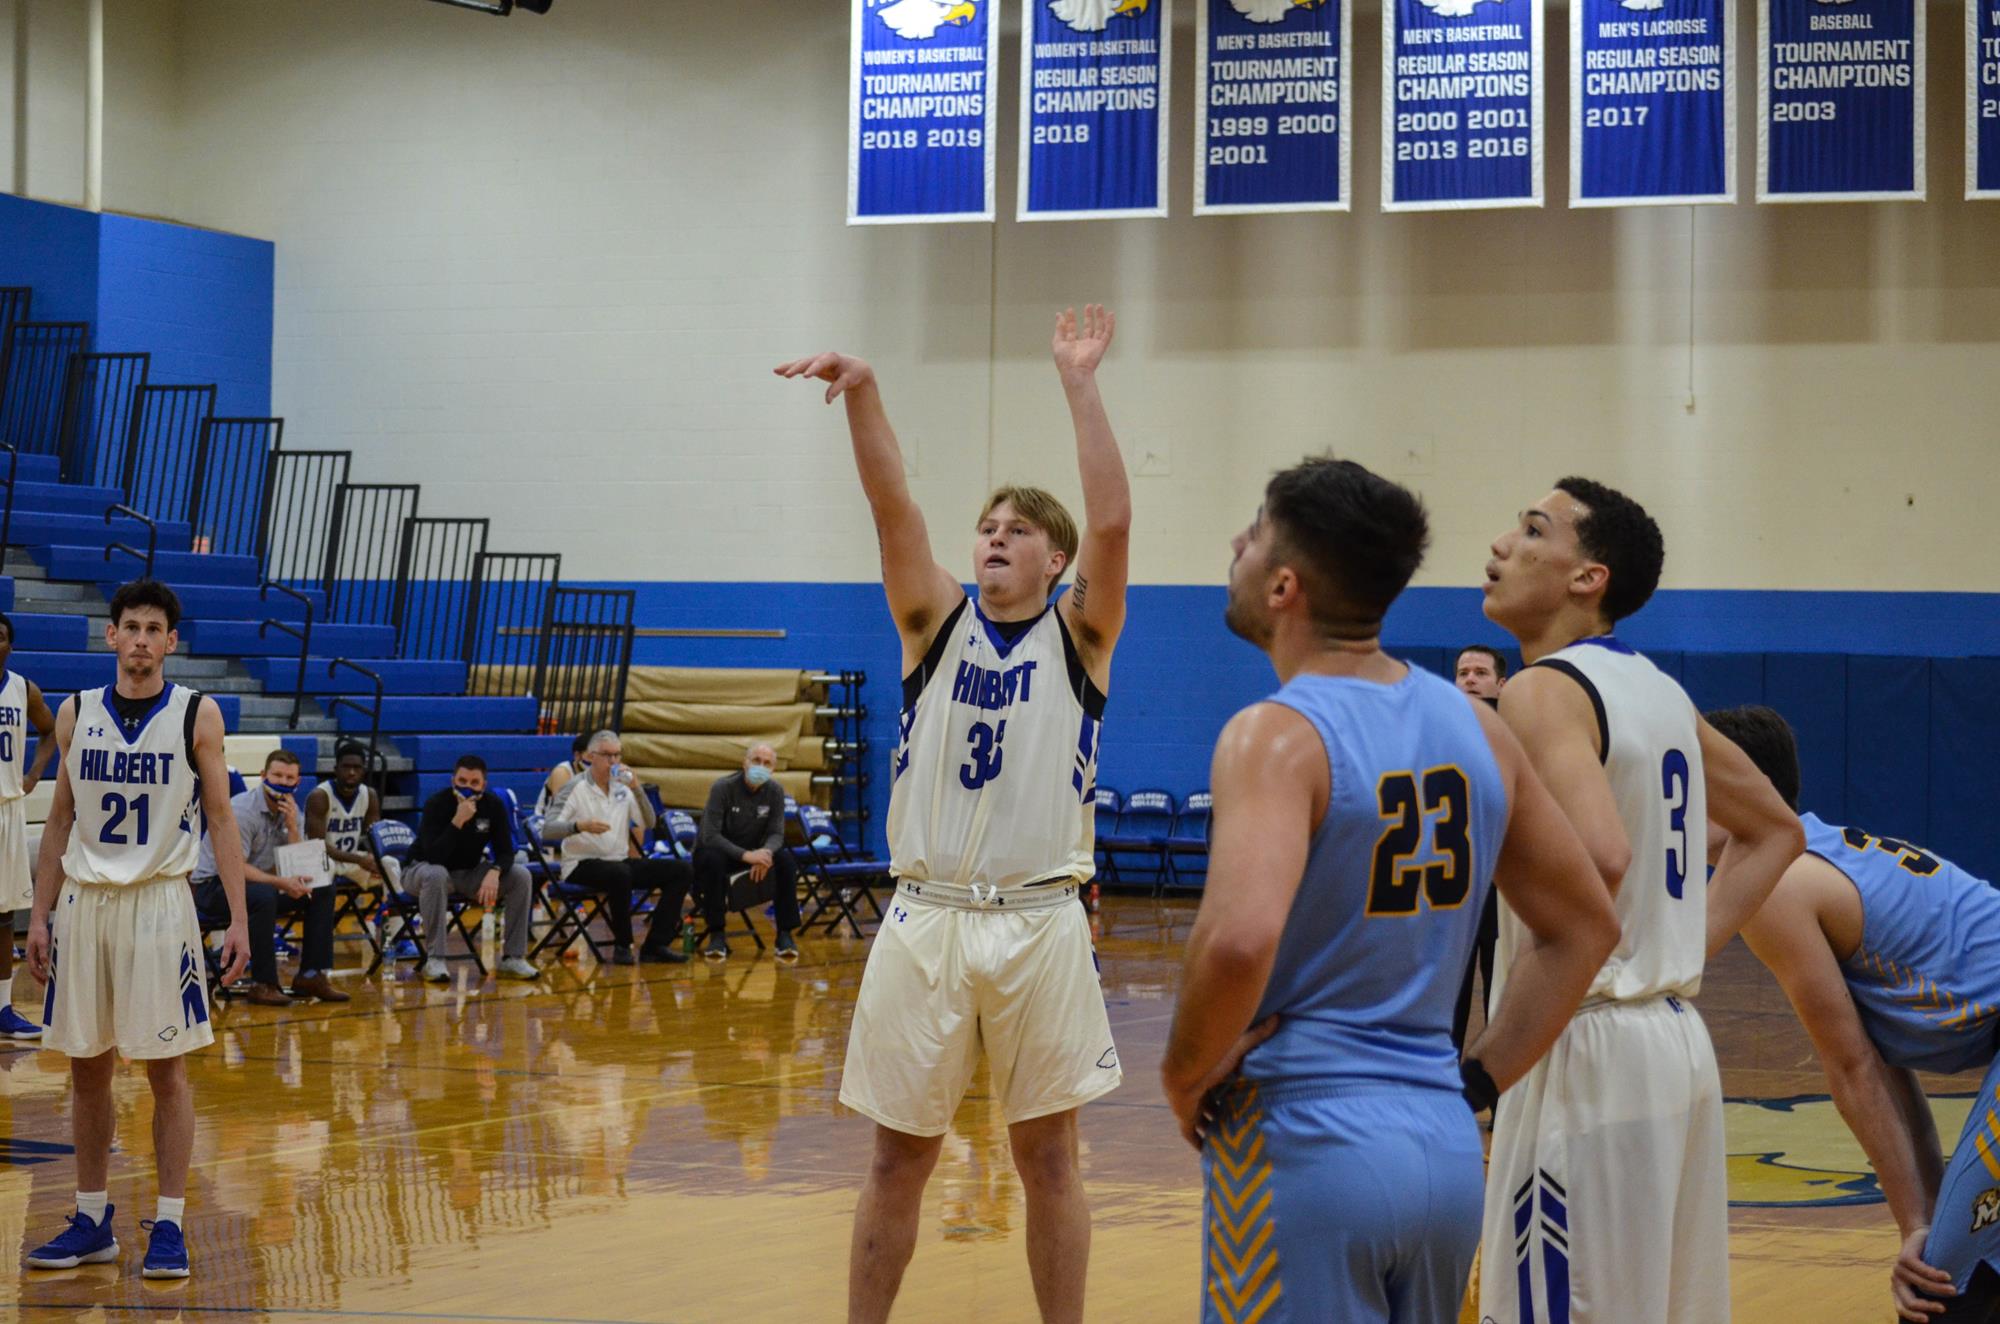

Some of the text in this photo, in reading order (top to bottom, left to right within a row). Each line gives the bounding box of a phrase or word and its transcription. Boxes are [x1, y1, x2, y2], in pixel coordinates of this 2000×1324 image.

[1599, 19, 1707, 37] MEN'S LACROSSE
[1811, 14, 1872, 30] BASEBALL
[1217, 32, 1332, 50] MEN'S BASKETBALL
[1404, 25, 1522, 44] MEN'S BASKETBALL
[864, 47, 983, 65] WOMEN'S BASKETBALL
[1035, 40, 1156, 58] WOMEN'S BASKETBALL
[1587, 45, 1719, 69] REGULAR SEASON
[1774, 40, 1910, 63] TOURNAMENT
[1211, 57, 1337, 82] TOURNAMENT
[1398, 51, 1528, 75] REGULAR SEASON
[864, 71, 983, 96] TOURNAMENT
[1035, 66, 1156, 88] REGULAR SEASON
[1399, 74, 1528, 100] CHAMPIONS
[1587, 67, 1720, 95] CHAMPIONS
[1774, 64, 1910, 89] CHAMPIONS
[1035, 87, 1155, 113] CHAMPIONS
[1211, 80, 1337, 105] CHAMPIONS
[864, 93, 982, 119] CHAMPIONS
[1587, 107, 1648, 127] 2017
[1774, 102, 1835, 121] 2003
[1211, 115, 1335, 136] 1999 2000
[1398, 109, 1528, 131] 2000 2001
[863, 129, 981, 149] 2018 2019
[1034, 125, 1088, 144] 2018
[1210, 146, 1267, 164] 2001
[1398, 137, 1527, 160] 2013 2016
[80, 749, 174, 785] HILBERT
[99, 792, 150, 846] 21
[1662, 749, 1689, 900] 3
[335, 836, 356, 853] 12
[1364, 763, 1472, 919] 23
